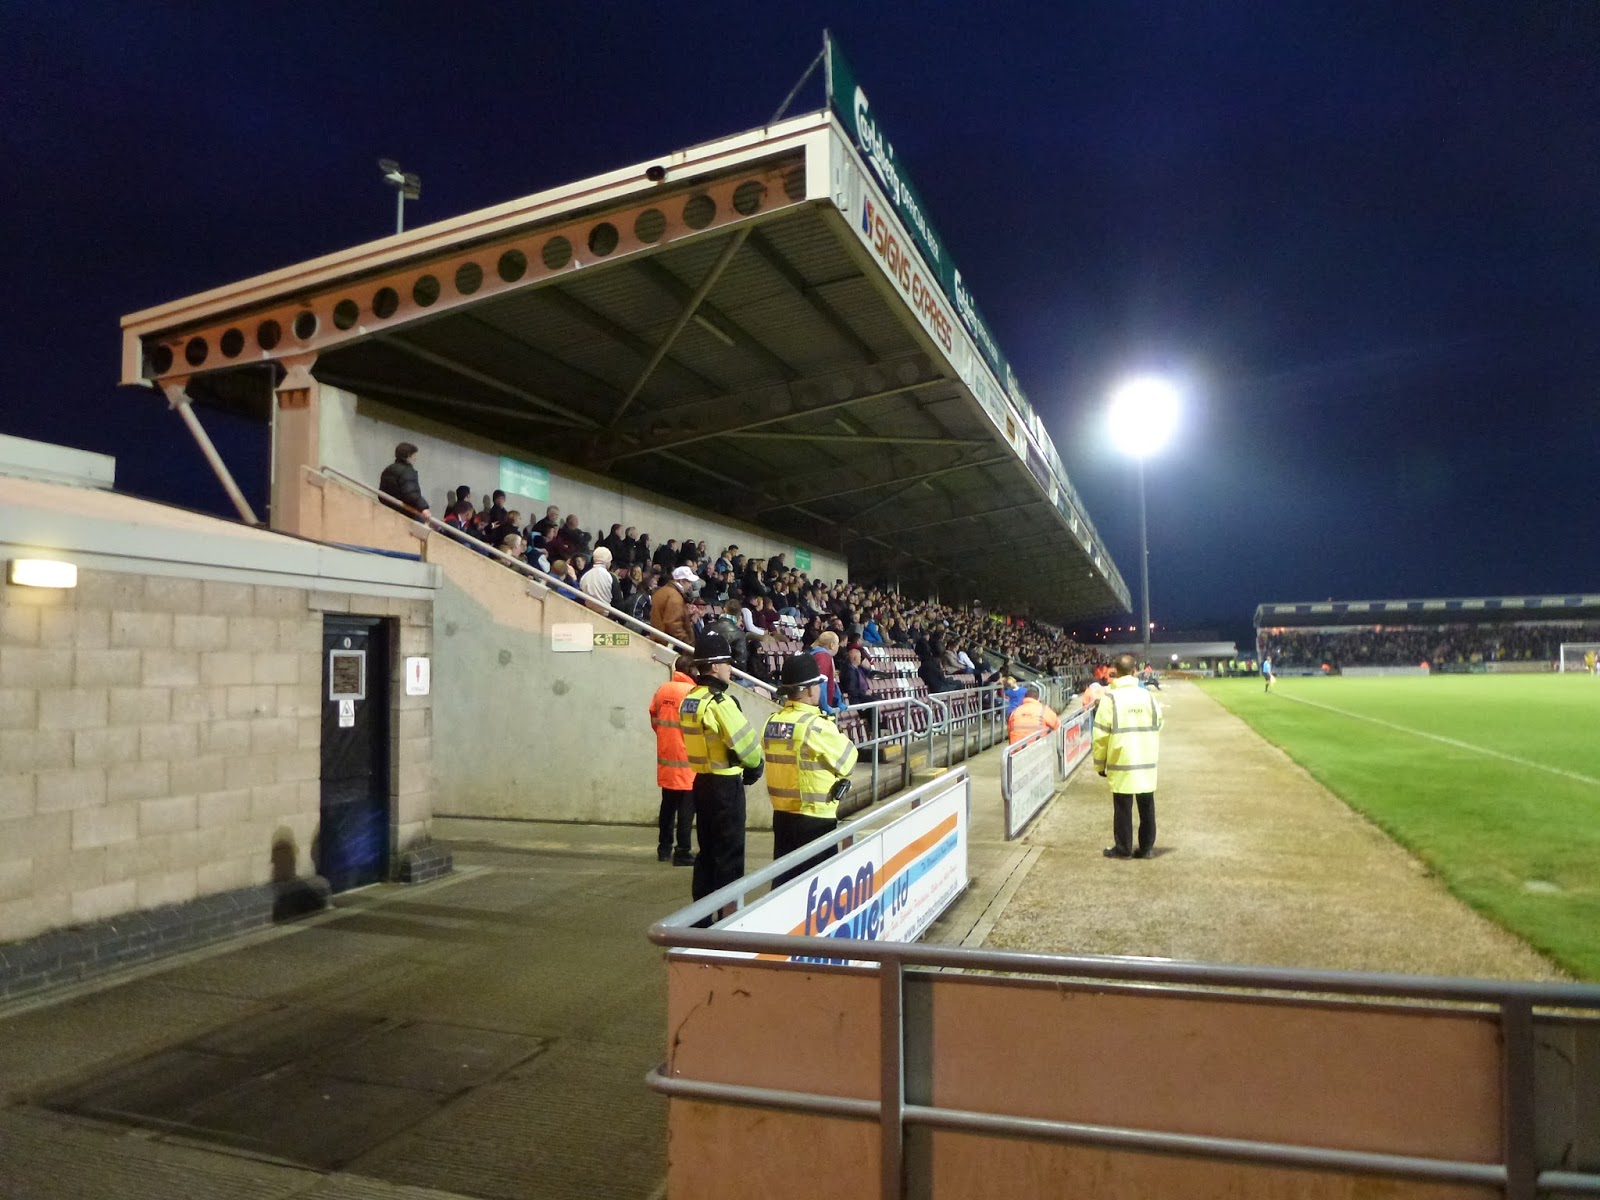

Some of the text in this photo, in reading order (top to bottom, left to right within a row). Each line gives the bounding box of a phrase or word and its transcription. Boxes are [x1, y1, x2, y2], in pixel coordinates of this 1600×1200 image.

[874, 215, 952, 354] SIGNS EXPRESS
[805, 861, 874, 935] foam
[891, 869, 910, 917] Ltd
